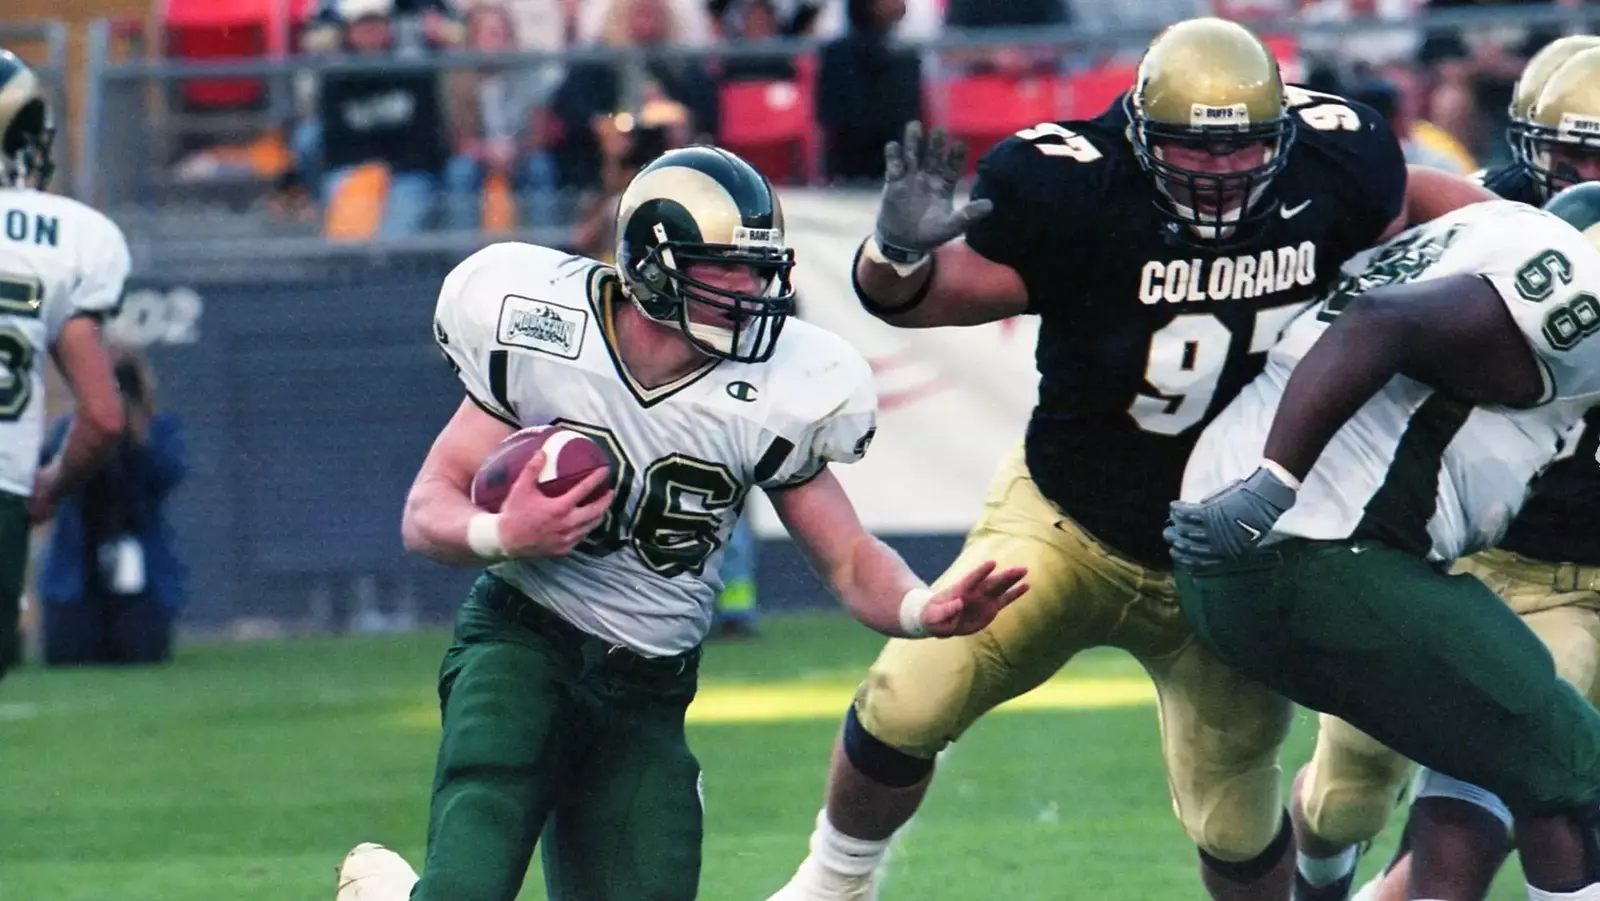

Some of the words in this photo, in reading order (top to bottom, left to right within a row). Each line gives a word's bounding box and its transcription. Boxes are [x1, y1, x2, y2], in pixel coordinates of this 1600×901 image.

[1206, 108, 1233, 118] BUFFS
[749, 230, 770, 241] RAMS
[1138, 241, 1316, 304] COLORADO
[1514, 249, 1600, 352] 68
